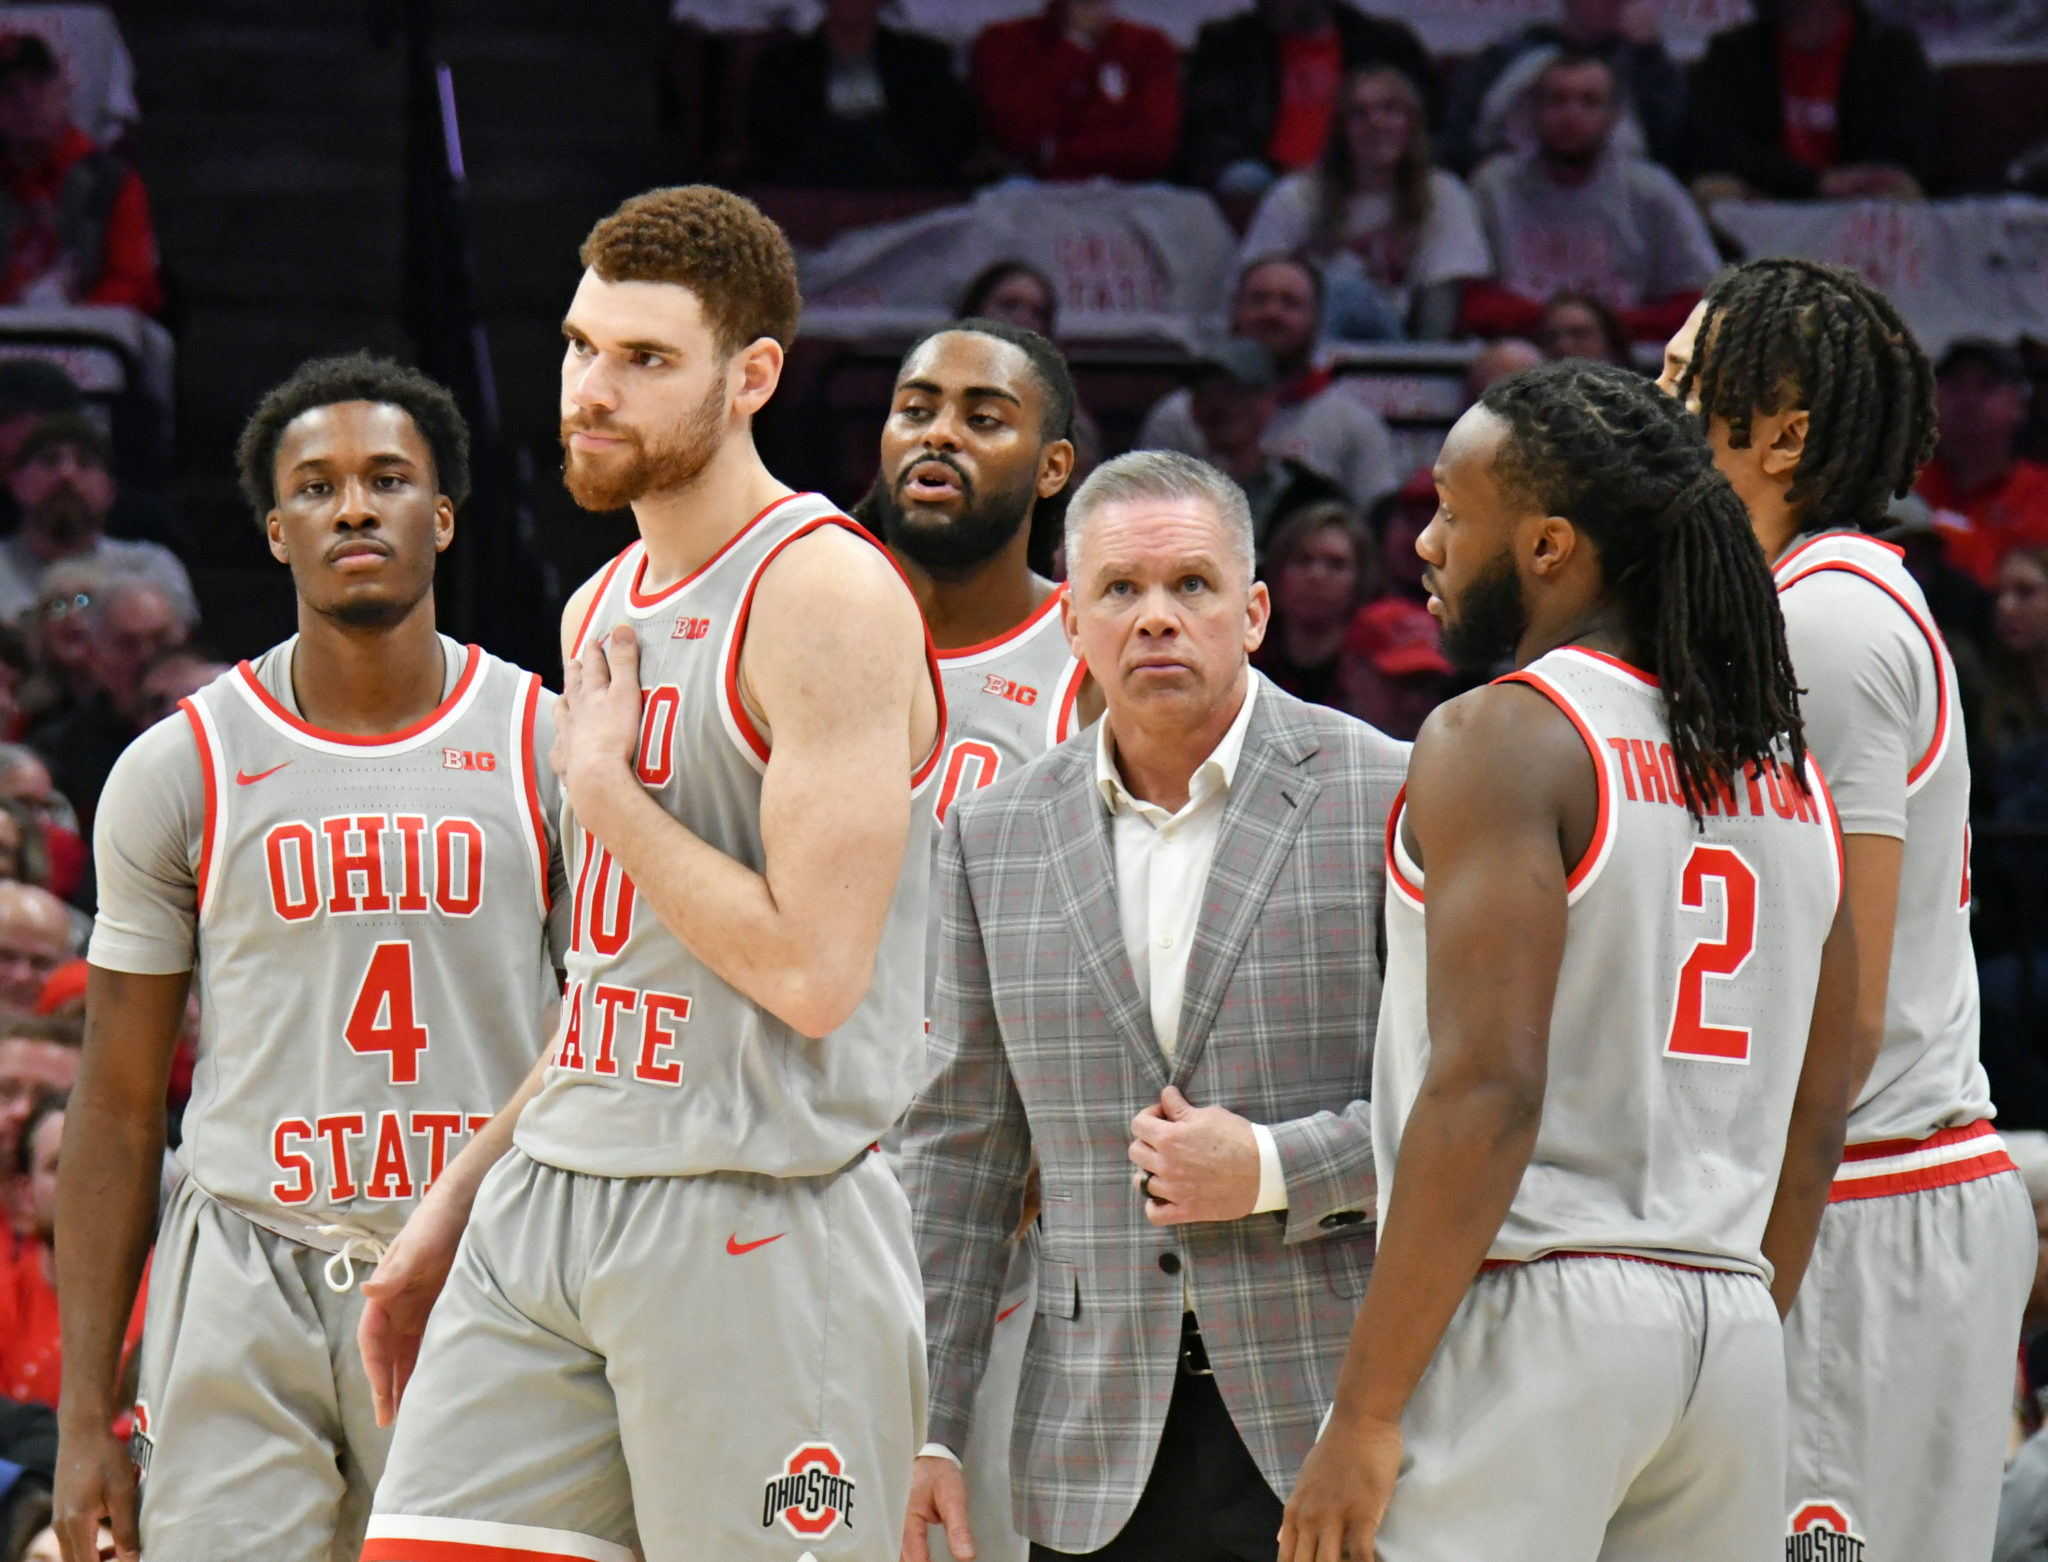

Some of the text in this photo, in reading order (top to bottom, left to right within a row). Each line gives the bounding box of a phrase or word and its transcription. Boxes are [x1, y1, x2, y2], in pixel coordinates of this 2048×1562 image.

[264, 813, 486, 923] OHIO
[343, 940, 428, 1086] 4
[1664, 843, 1759, 1065] 2
